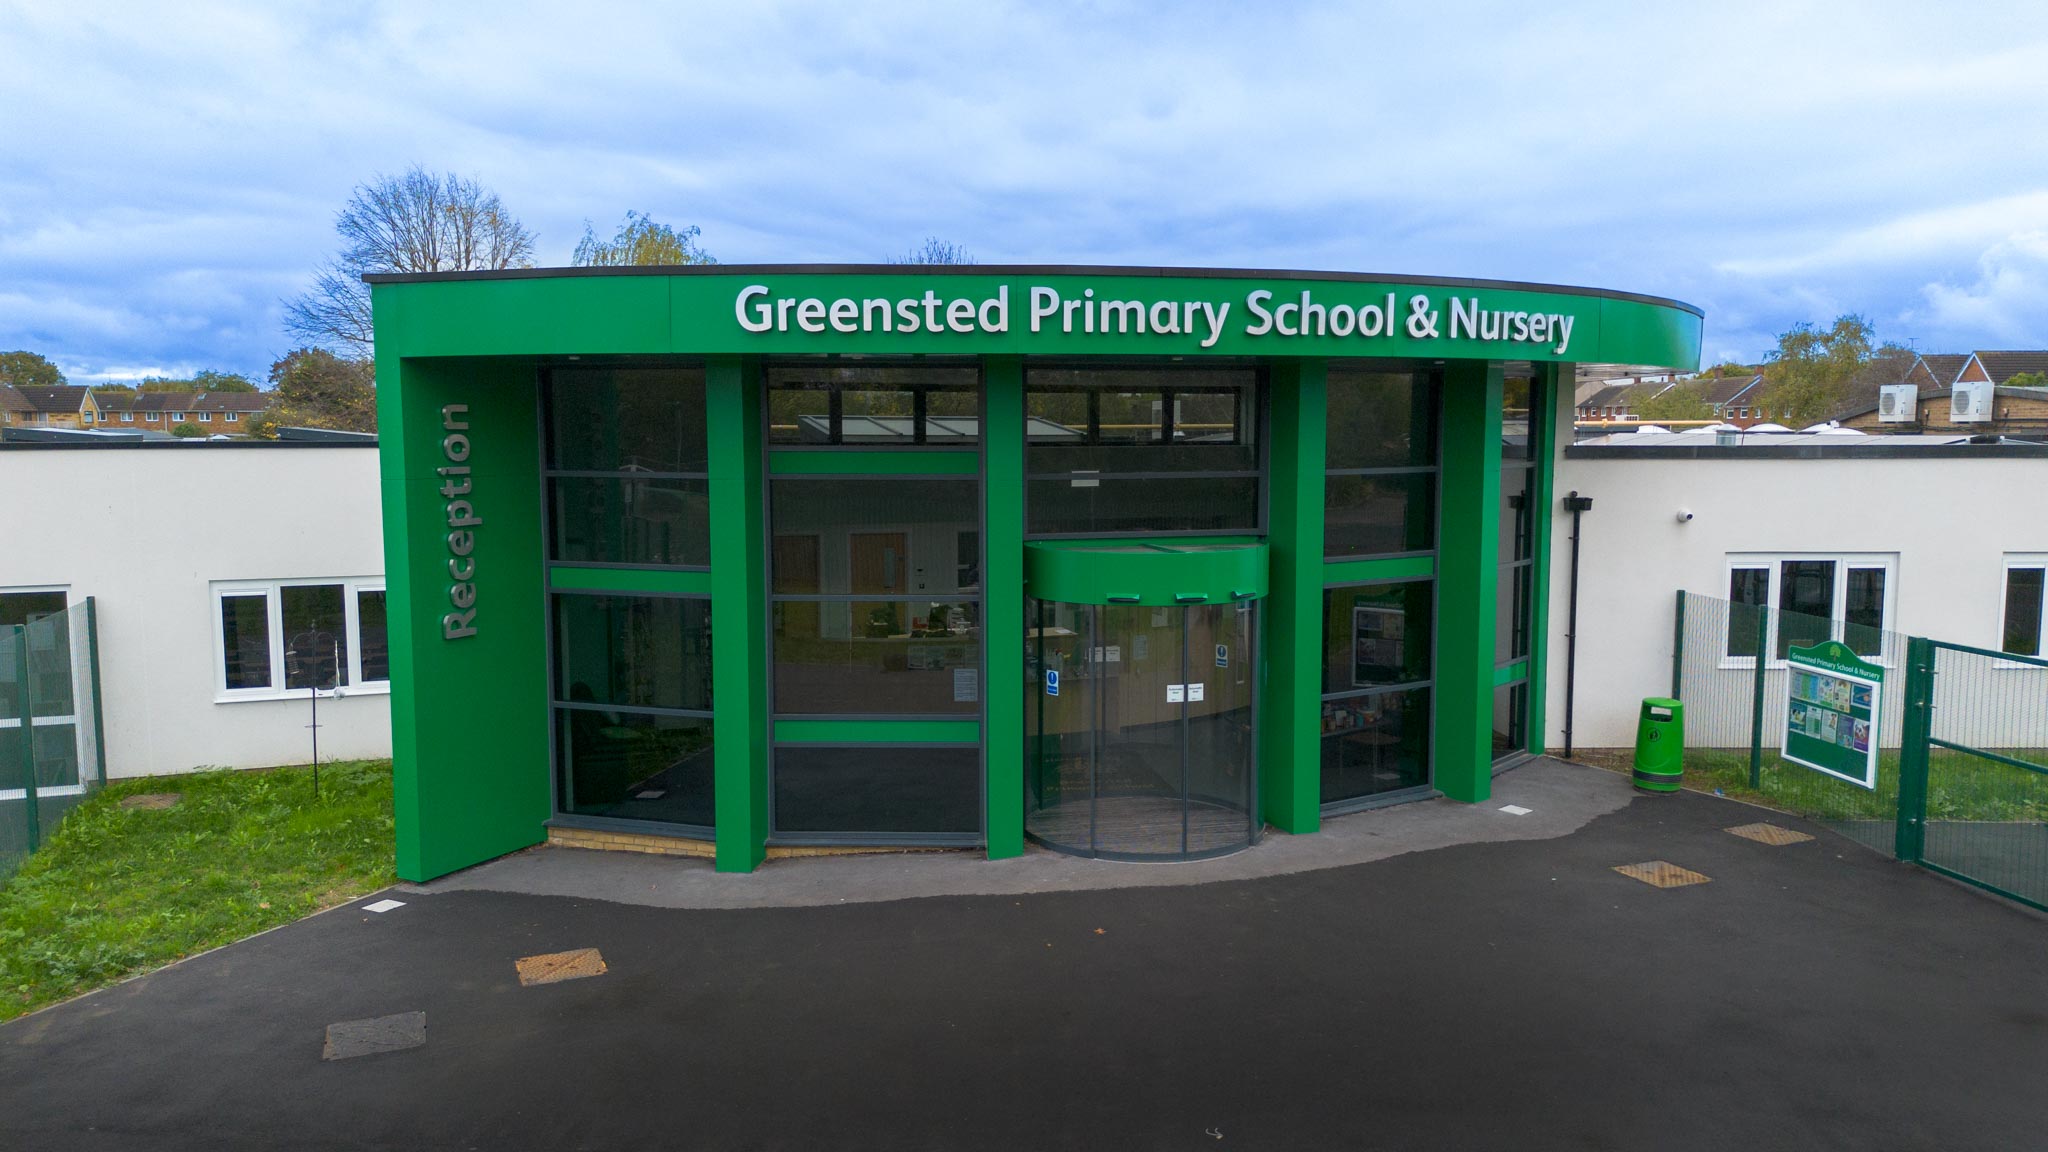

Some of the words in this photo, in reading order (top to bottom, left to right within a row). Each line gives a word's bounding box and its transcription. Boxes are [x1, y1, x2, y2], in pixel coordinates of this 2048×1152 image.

[735, 285, 1009, 333] Greensted
[1030, 286, 1231, 348] Primary
[1245, 289, 1396, 337] School
[1406, 294, 1439, 339] &
[1449, 296, 1575, 355] Nursery
[437, 404, 483, 640] Reception
[1816, 657, 1836, 670] Primary
[1837, 662, 1854, 673] School
[1859, 669, 1881, 681] Nursery
